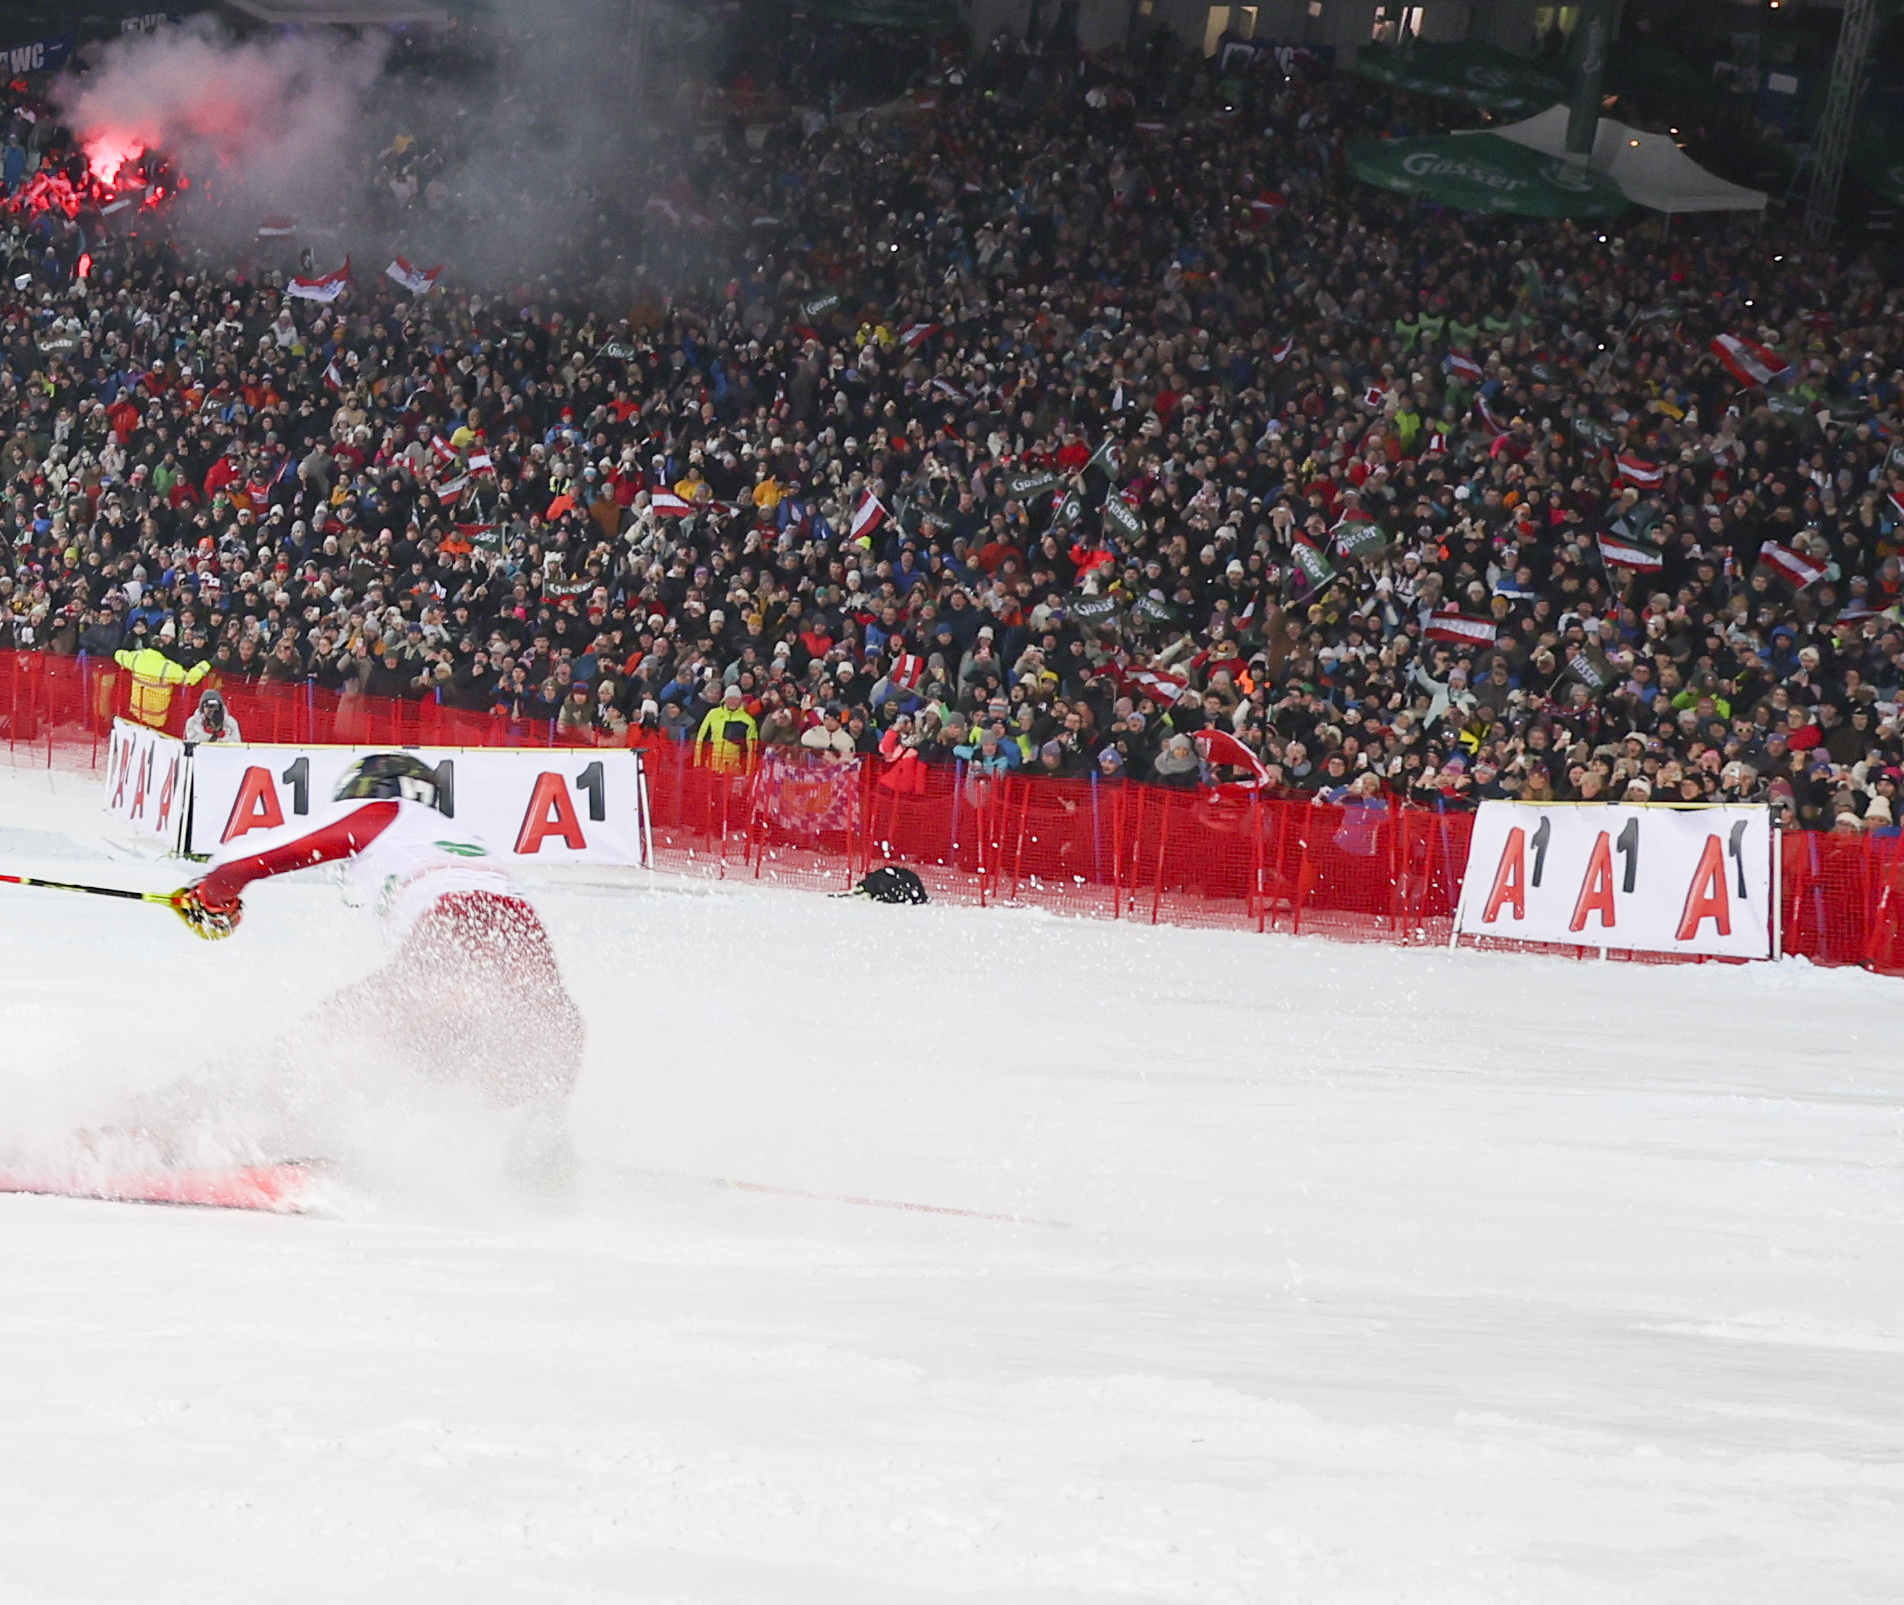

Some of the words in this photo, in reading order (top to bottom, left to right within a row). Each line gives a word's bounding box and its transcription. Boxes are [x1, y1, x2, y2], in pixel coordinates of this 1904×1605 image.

[10, 43, 44, 74] WC
[220, 756, 310, 844] A1
[513, 761, 606, 855] A1
[1481, 816, 1550, 923] A1
[1569, 817, 1639, 932] A1
[1675, 820, 1748, 941] A1
